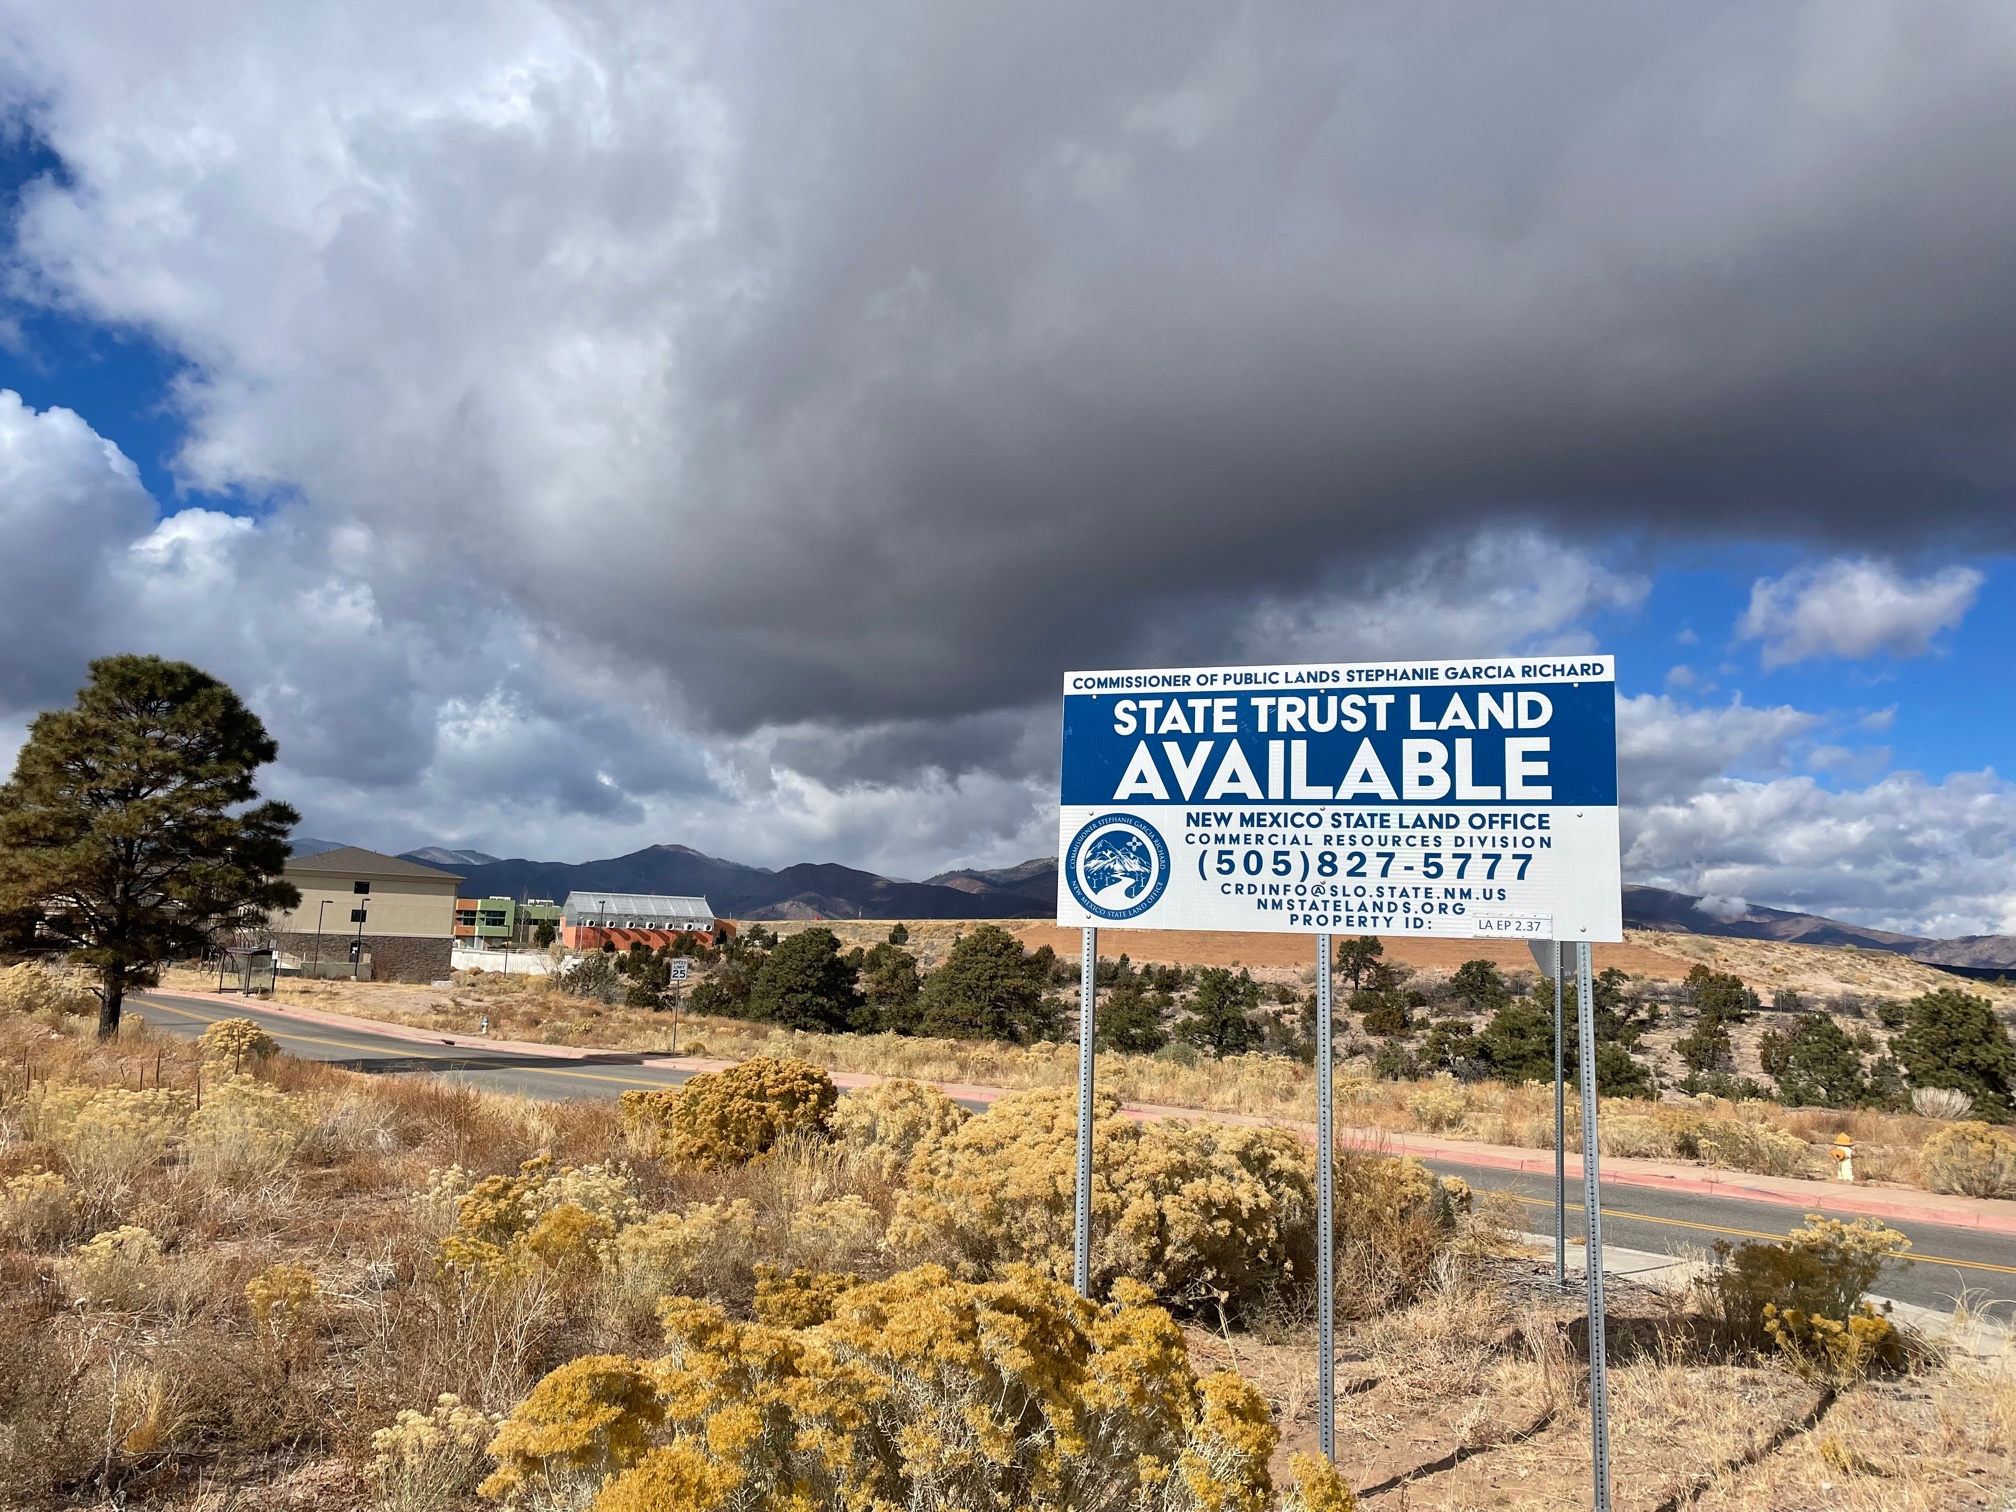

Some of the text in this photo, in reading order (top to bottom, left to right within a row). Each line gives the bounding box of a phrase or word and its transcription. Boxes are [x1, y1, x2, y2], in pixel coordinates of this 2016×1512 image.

[1072, 662, 1605, 690] COMMISSIONER OF PUBLIC LANDS STEPHANIE GARCIA RICHARD
[1113, 691, 1553, 736] STATE TRUST LAND
[1112, 736, 1553, 802] AVAILABLE
[1186, 811, 1551, 831] NEW MEXICO STATE LAND OFFICE
[1069, 817, 1166, 870] COMMISSIONER STEPHANIE GARCIA RICHARD
[1184, 832, 1552, 849] COMMERCIAL RESOURCES DIVISION
[1198, 849, 1533, 883] (505)827-5777
[1071, 880, 1083, 897] NEW
[1080, 896, 1106, 915] MEXICO
[1128, 903, 1148, 916] LAND
[1147, 881, 1163, 905] OFFICE
[1220, 881, 1507, 901] CRDINFO@SLO.STATE.NM.US
[1257, 898, 1466, 916] NMSTATELANDS.ORG
[1289, 913, 1432, 930] PROPERTY ID:
[1478, 919, 1541, 932] LA EP 2.37
[672, 969, 686, 979] 25
